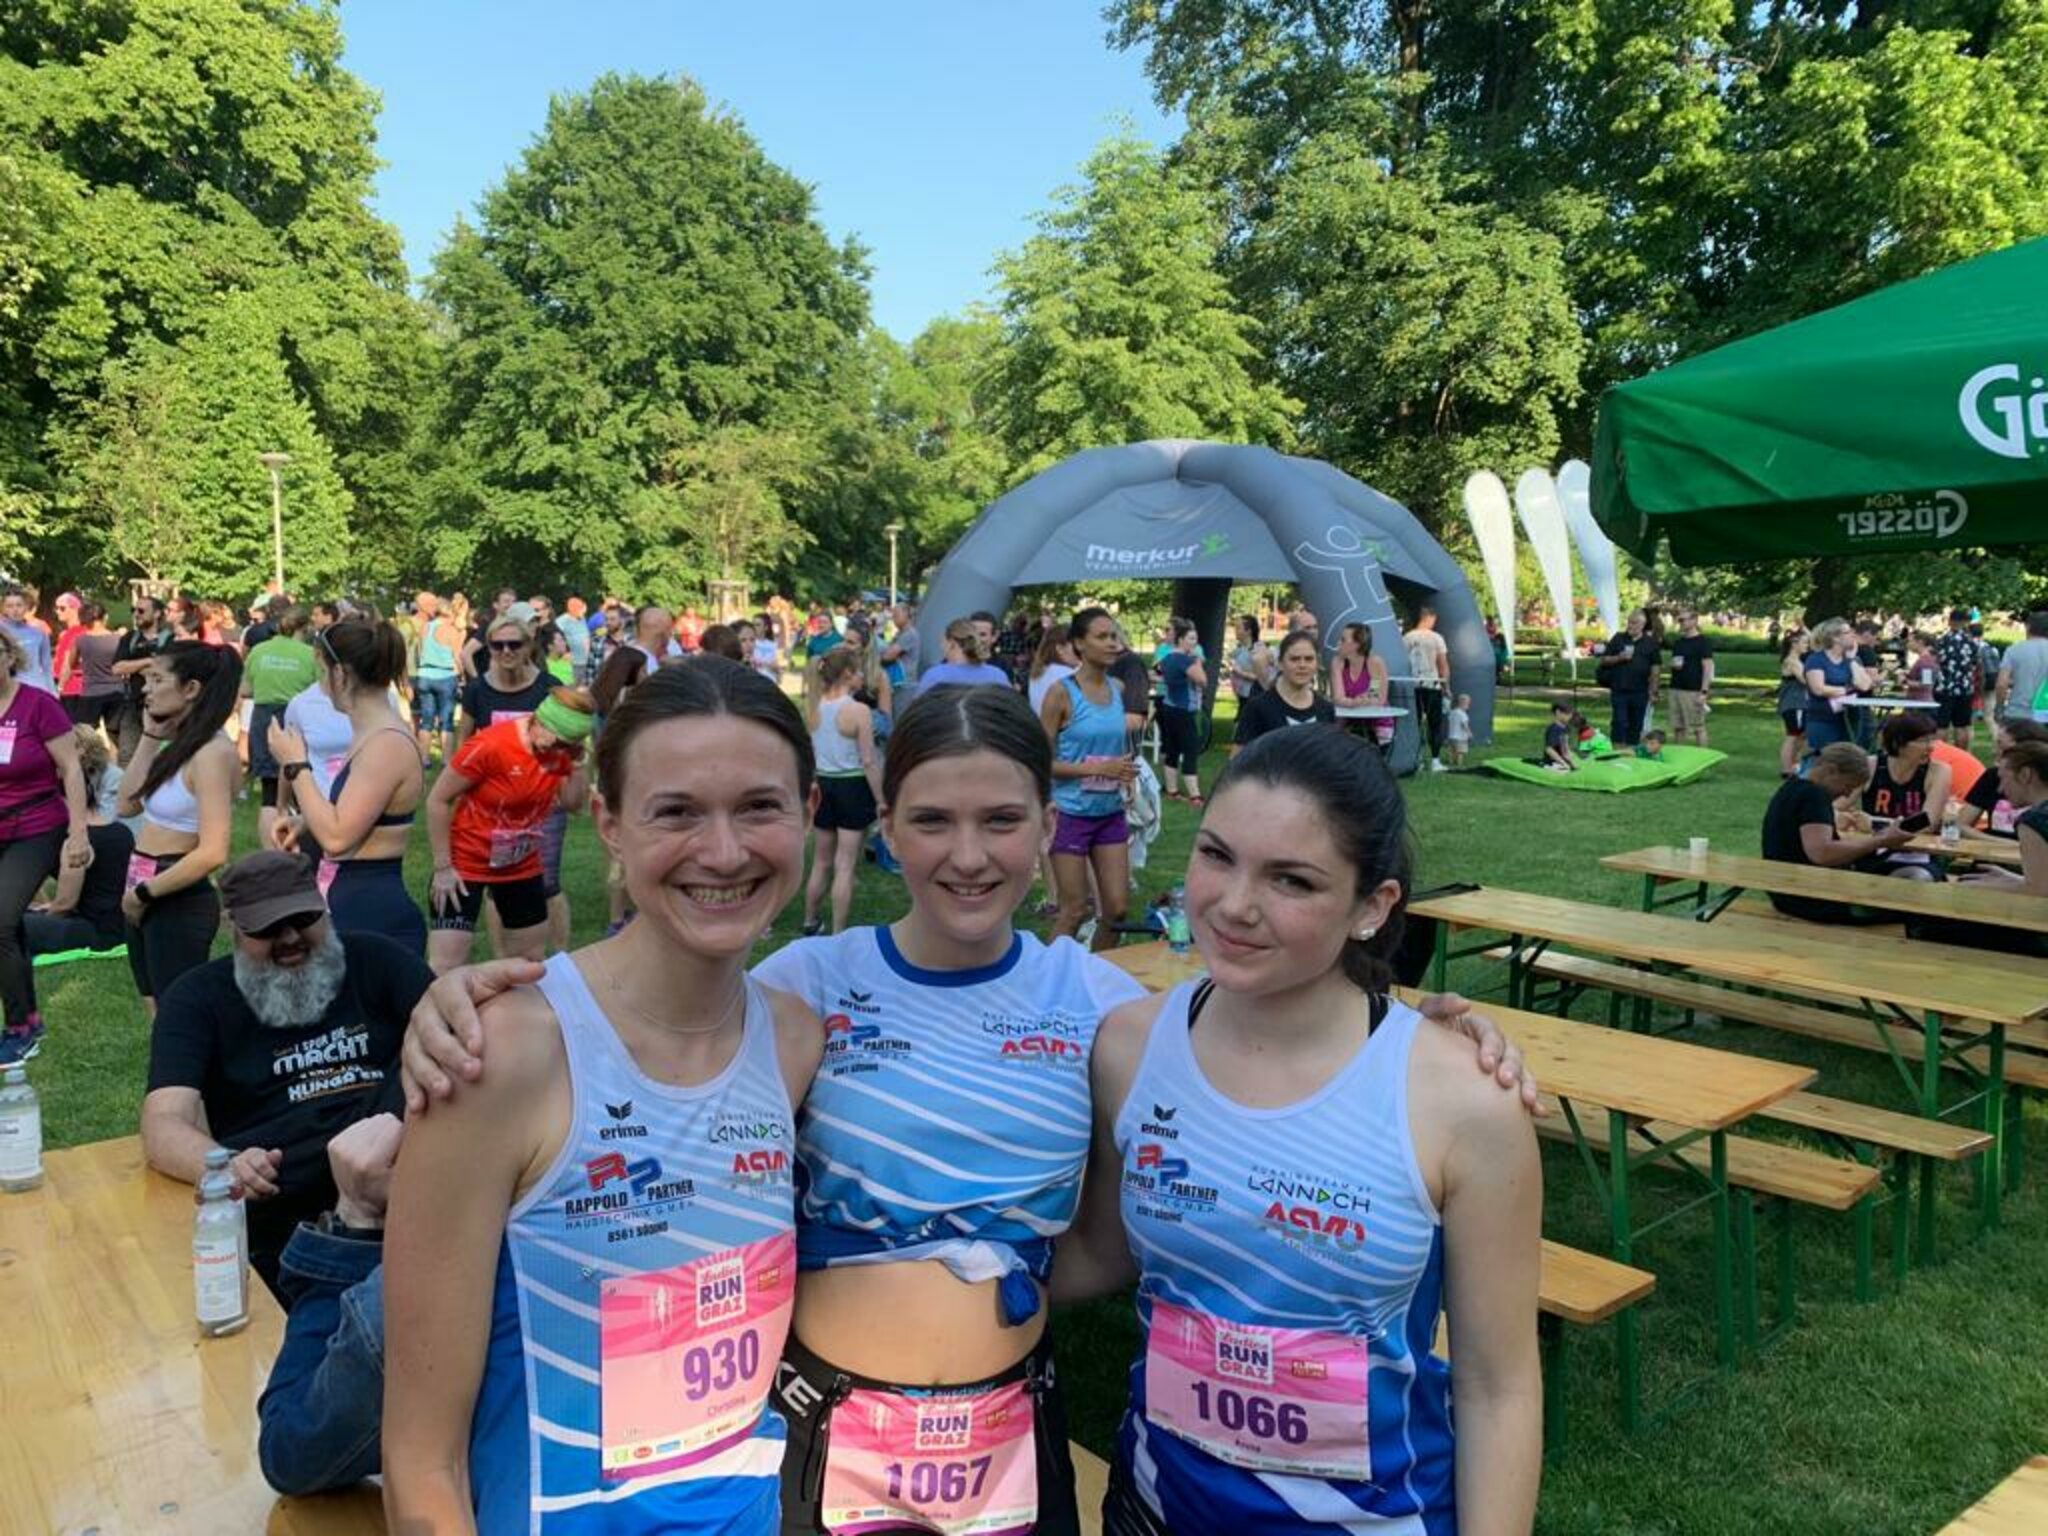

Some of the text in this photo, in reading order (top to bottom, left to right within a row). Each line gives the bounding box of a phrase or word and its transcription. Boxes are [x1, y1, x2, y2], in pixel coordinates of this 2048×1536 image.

[1087, 543, 1200, 563] merkur
[273, 1031, 369, 1075] MACHT
[600, 1123, 648, 1141] erima
[565, 1179, 695, 1216] RAPPOLD PARTNER
[1169, 1181, 1219, 1203] PARTNER
[1247, 1175, 1371, 1214] LANNACH
[699, 1274, 742, 1307] RUN
[700, 1296, 743, 1323] GRAZ
[683, 1328, 760, 1402] 930
[1218, 1341, 1270, 1367] RUN
[1218, 1359, 1270, 1380] GRAZ
[920, 1414, 969, 1433] RUN
[1191, 1380, 1309, 1445] 1066
[919, 1432, 967, 1447] GRAZ
[884, 1454, 993, 1503] 1067
